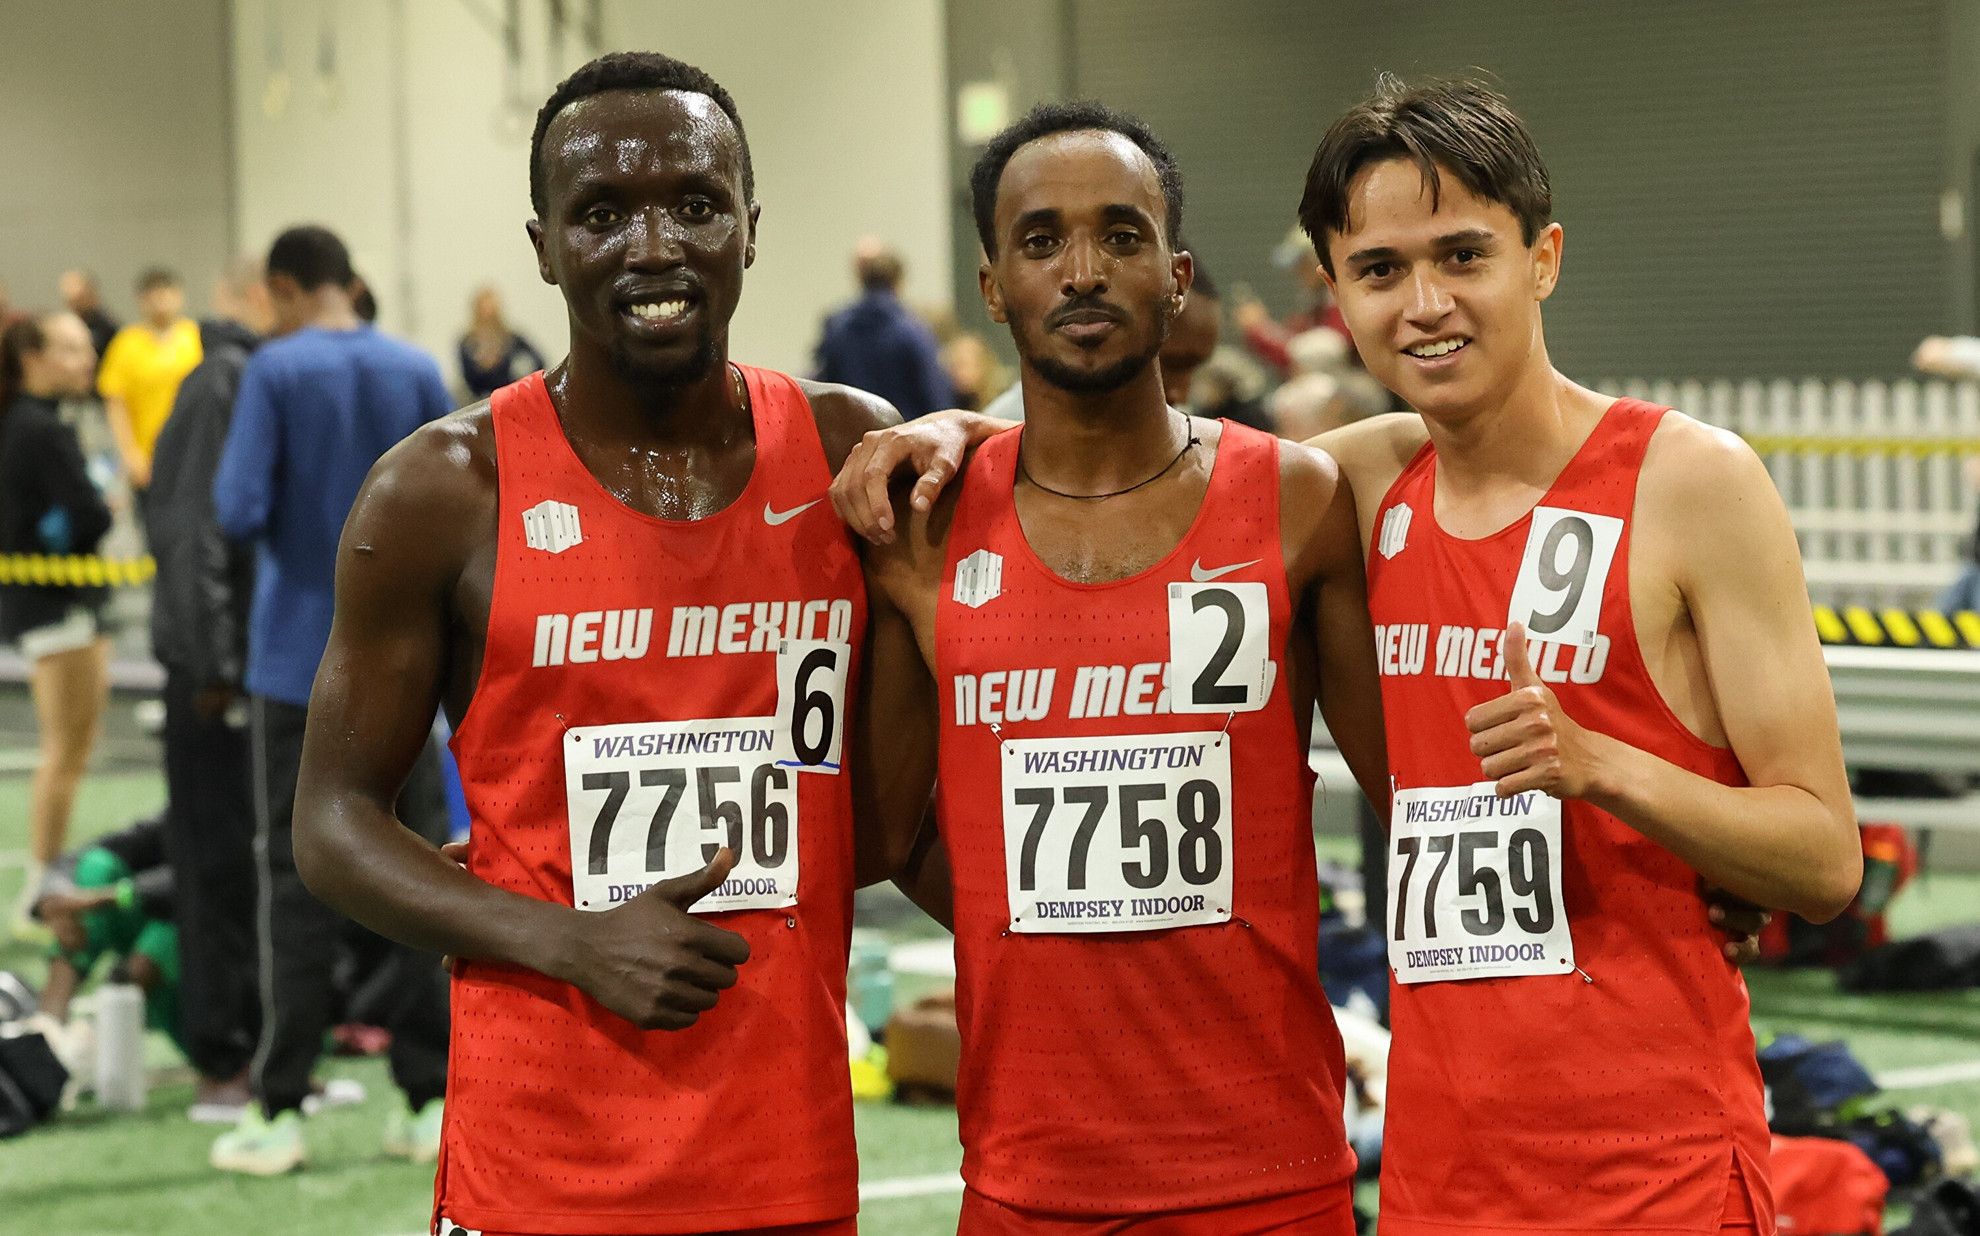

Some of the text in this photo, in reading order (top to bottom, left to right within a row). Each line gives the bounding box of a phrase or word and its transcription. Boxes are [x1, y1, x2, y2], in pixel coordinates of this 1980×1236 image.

[1528, 516, 1593, 634] 9
[532, 598, 852, 668] NEW MEXICO
[1191, 588, 1248, 705] 2
[791, 648, 837, 766] 6
[954, 668, 1057, 726] NEW
[593, 729, 775, 759] WASHINGTON
[1024, 745, 1206, 774] WASHINGTON
[582, 763, 789, 876] 7756
[1014, 778, 1223, 892] 7758
[1405, 793, 1536, 824] WASHINGTON
[1036, 895, 1205, 919] DEMPSEY INDOOR
[1395, 828, 1555, 942] 7759
[1406, 943, 1545, 968] DEMPSEY INDOOR
